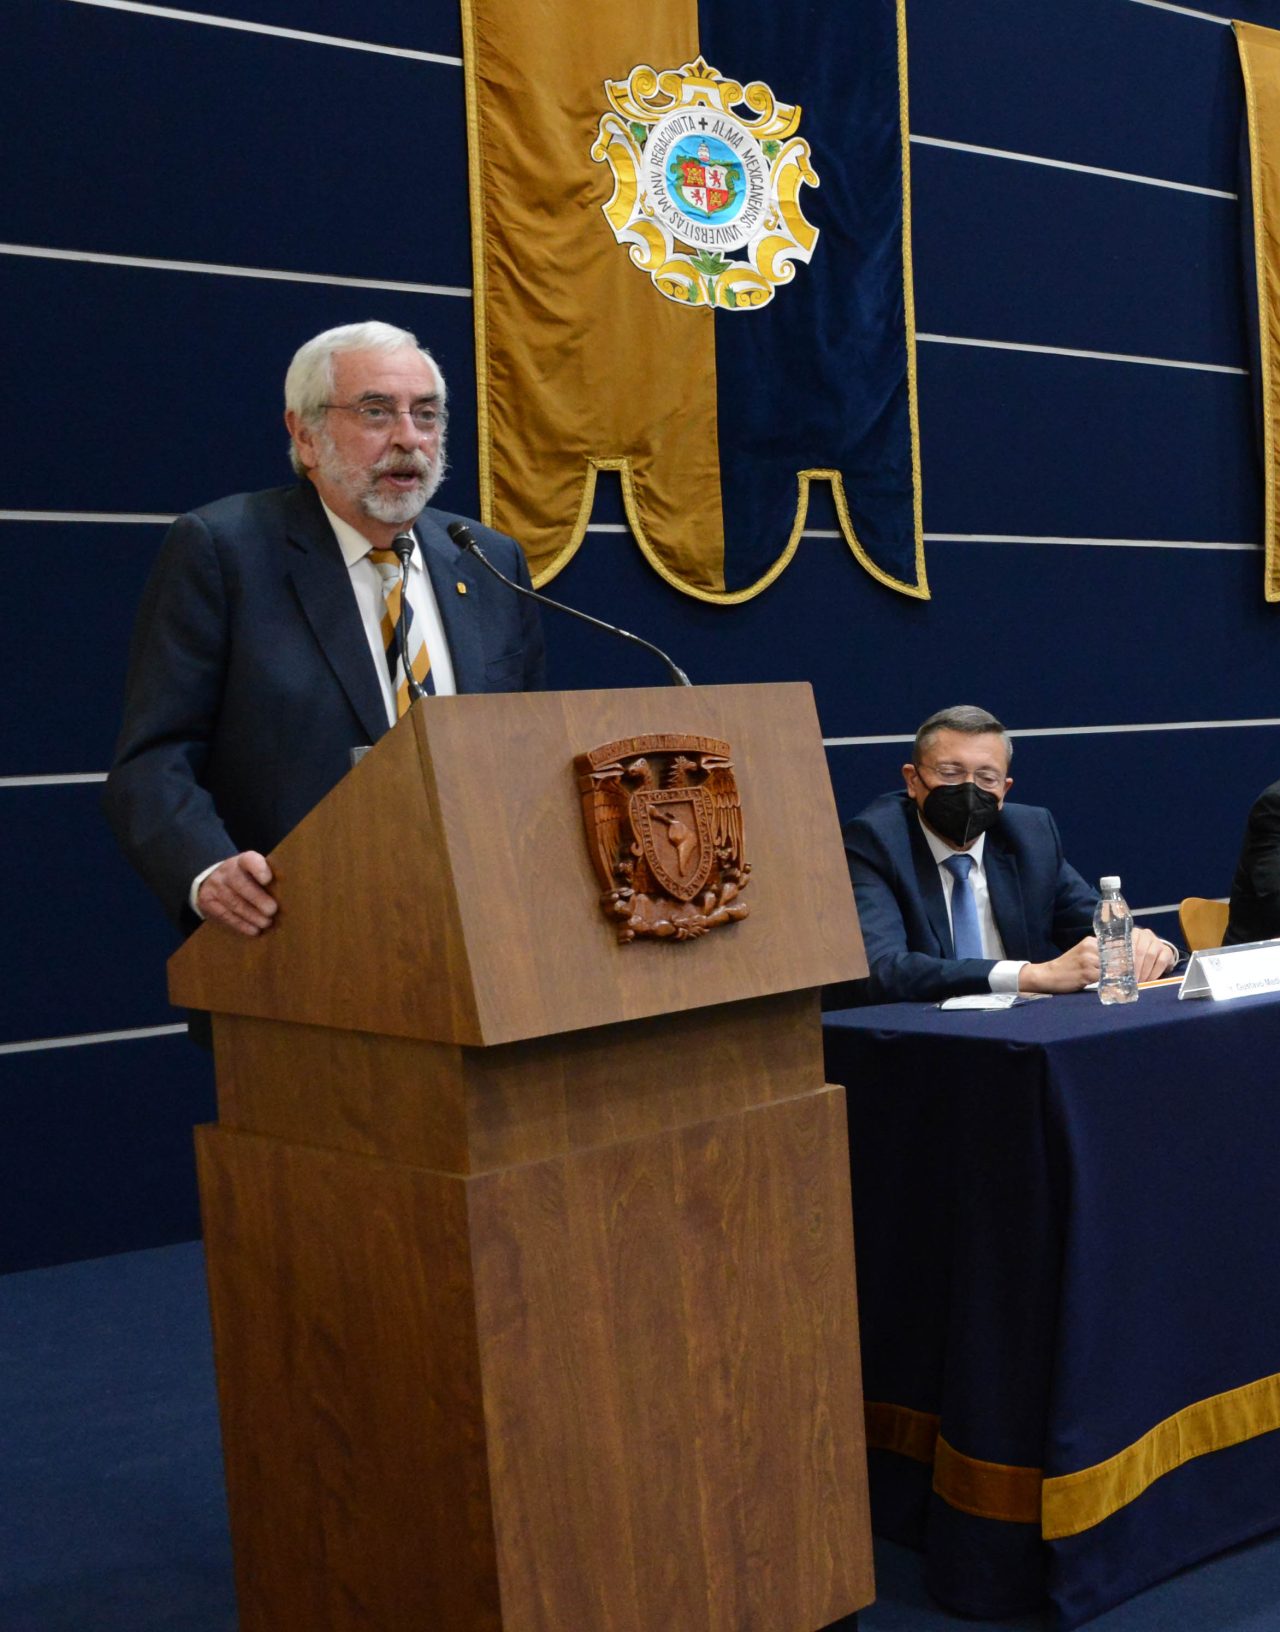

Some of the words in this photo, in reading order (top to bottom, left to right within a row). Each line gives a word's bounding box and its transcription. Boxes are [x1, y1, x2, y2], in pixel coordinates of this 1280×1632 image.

[712, 120, 744, 149] ALMA
[651, 170, 671, 213] MANV
[740, 148, 763, 229] MEXICANENSIS
